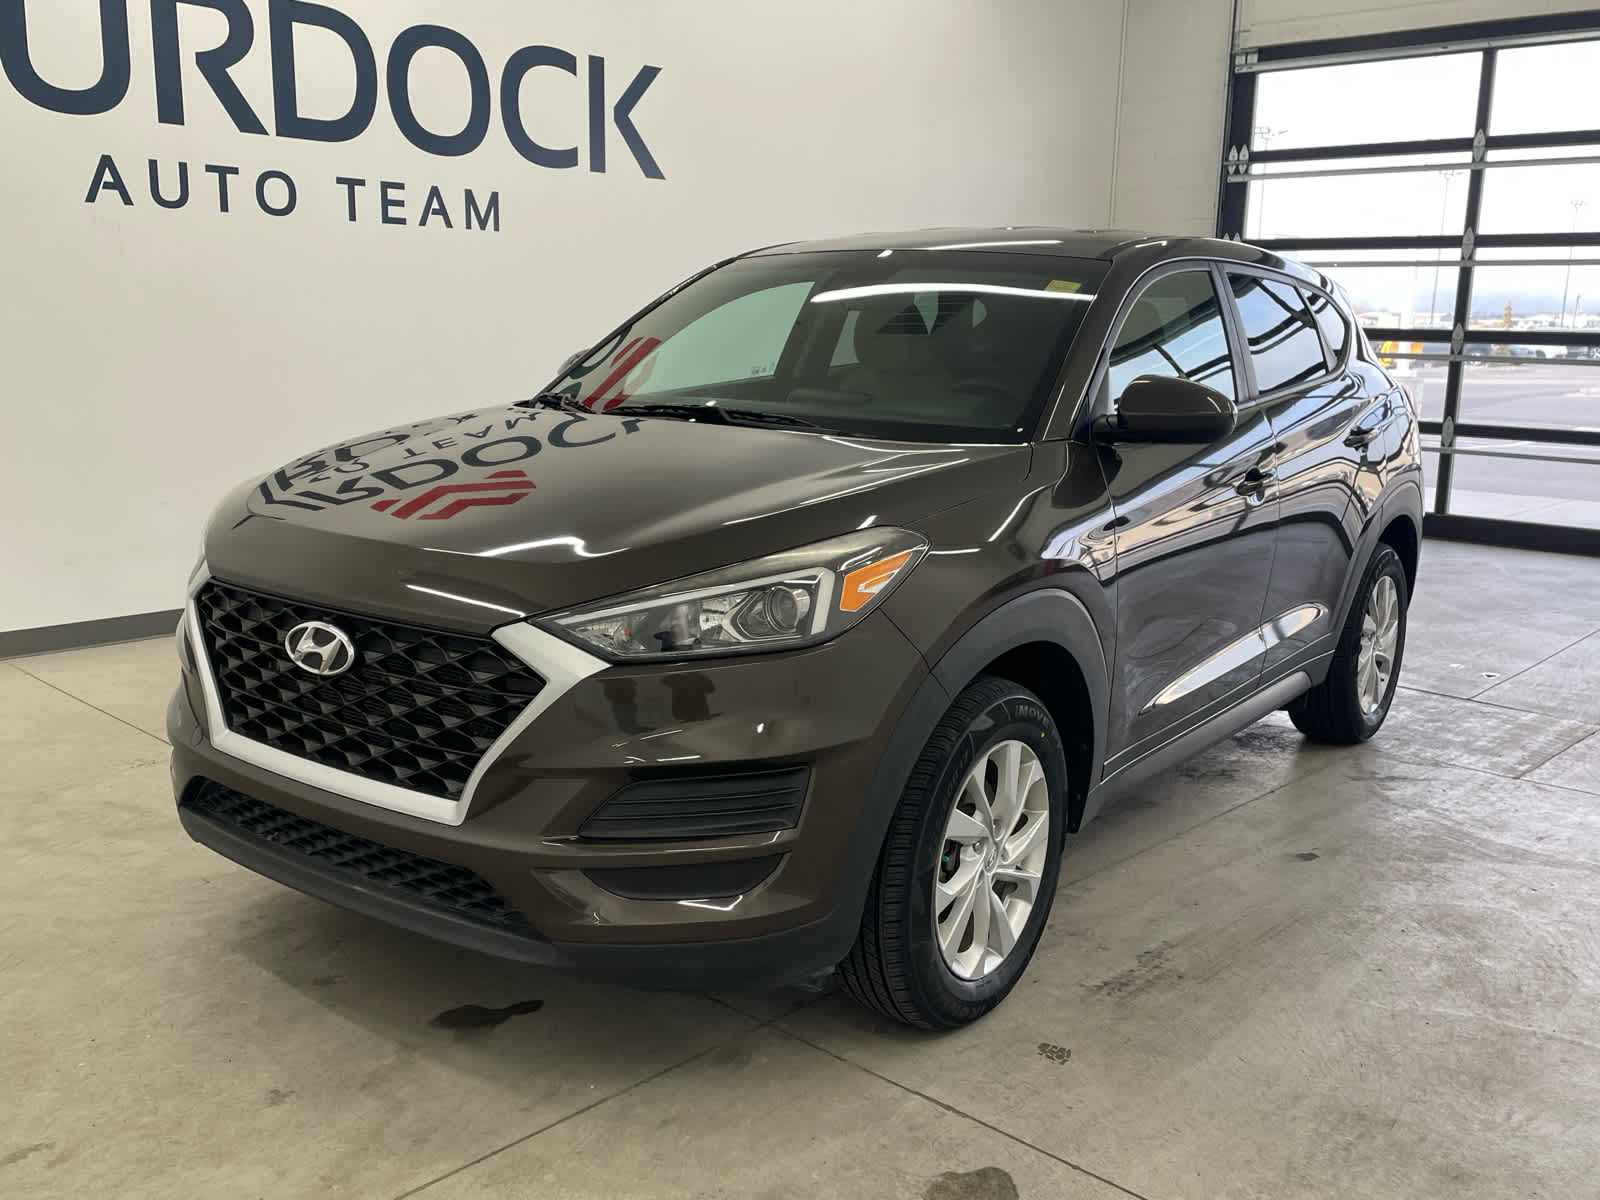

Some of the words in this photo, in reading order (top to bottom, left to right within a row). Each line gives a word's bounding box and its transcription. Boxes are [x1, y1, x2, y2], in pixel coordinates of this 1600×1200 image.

[0, 0, 666, 180] URDOCK
[85, 154, 297, 216] AUTO
[335, 176, 500, 232] TEAM
